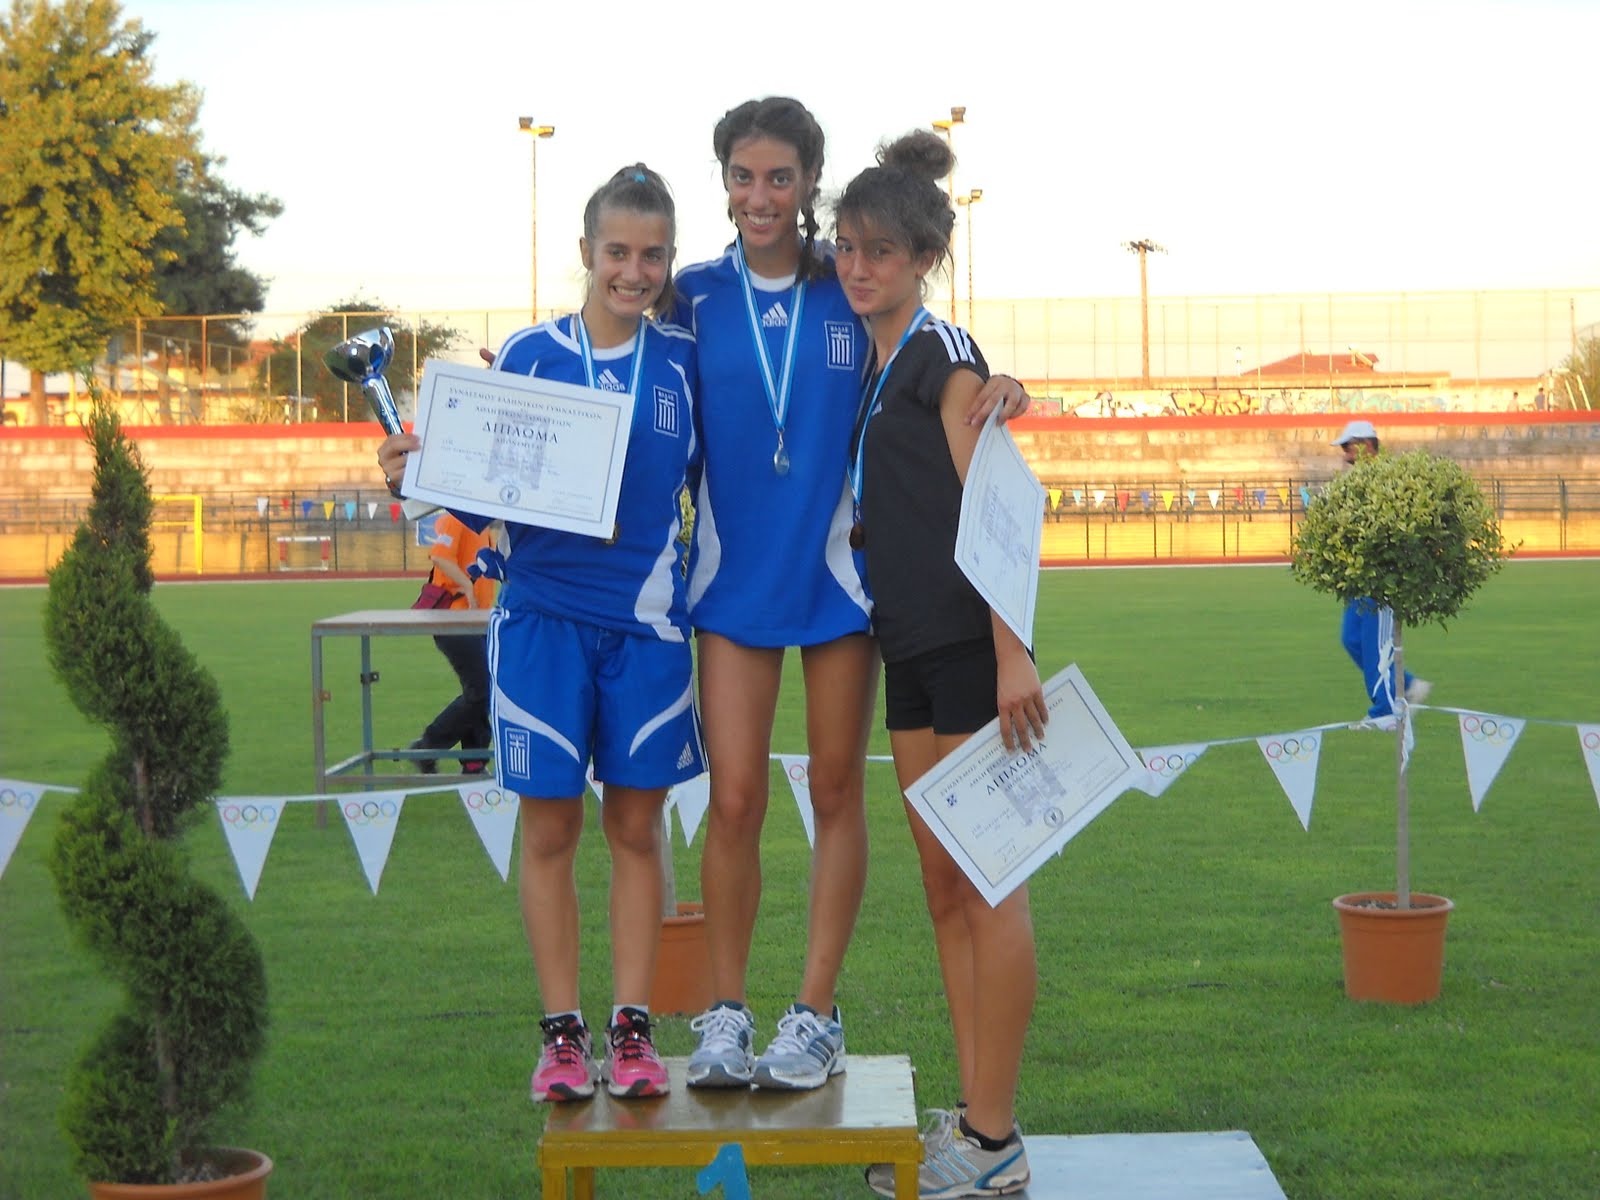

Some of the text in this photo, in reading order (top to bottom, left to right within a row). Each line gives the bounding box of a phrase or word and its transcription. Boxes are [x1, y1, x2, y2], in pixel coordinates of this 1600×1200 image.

[482, 421, 558, 444] ΔΙΠΛΩΜΑ
[985, 741, 1047, 794] ΔΙΠΛΩΜΑ
[696, 1142, 752, 1200] 1
